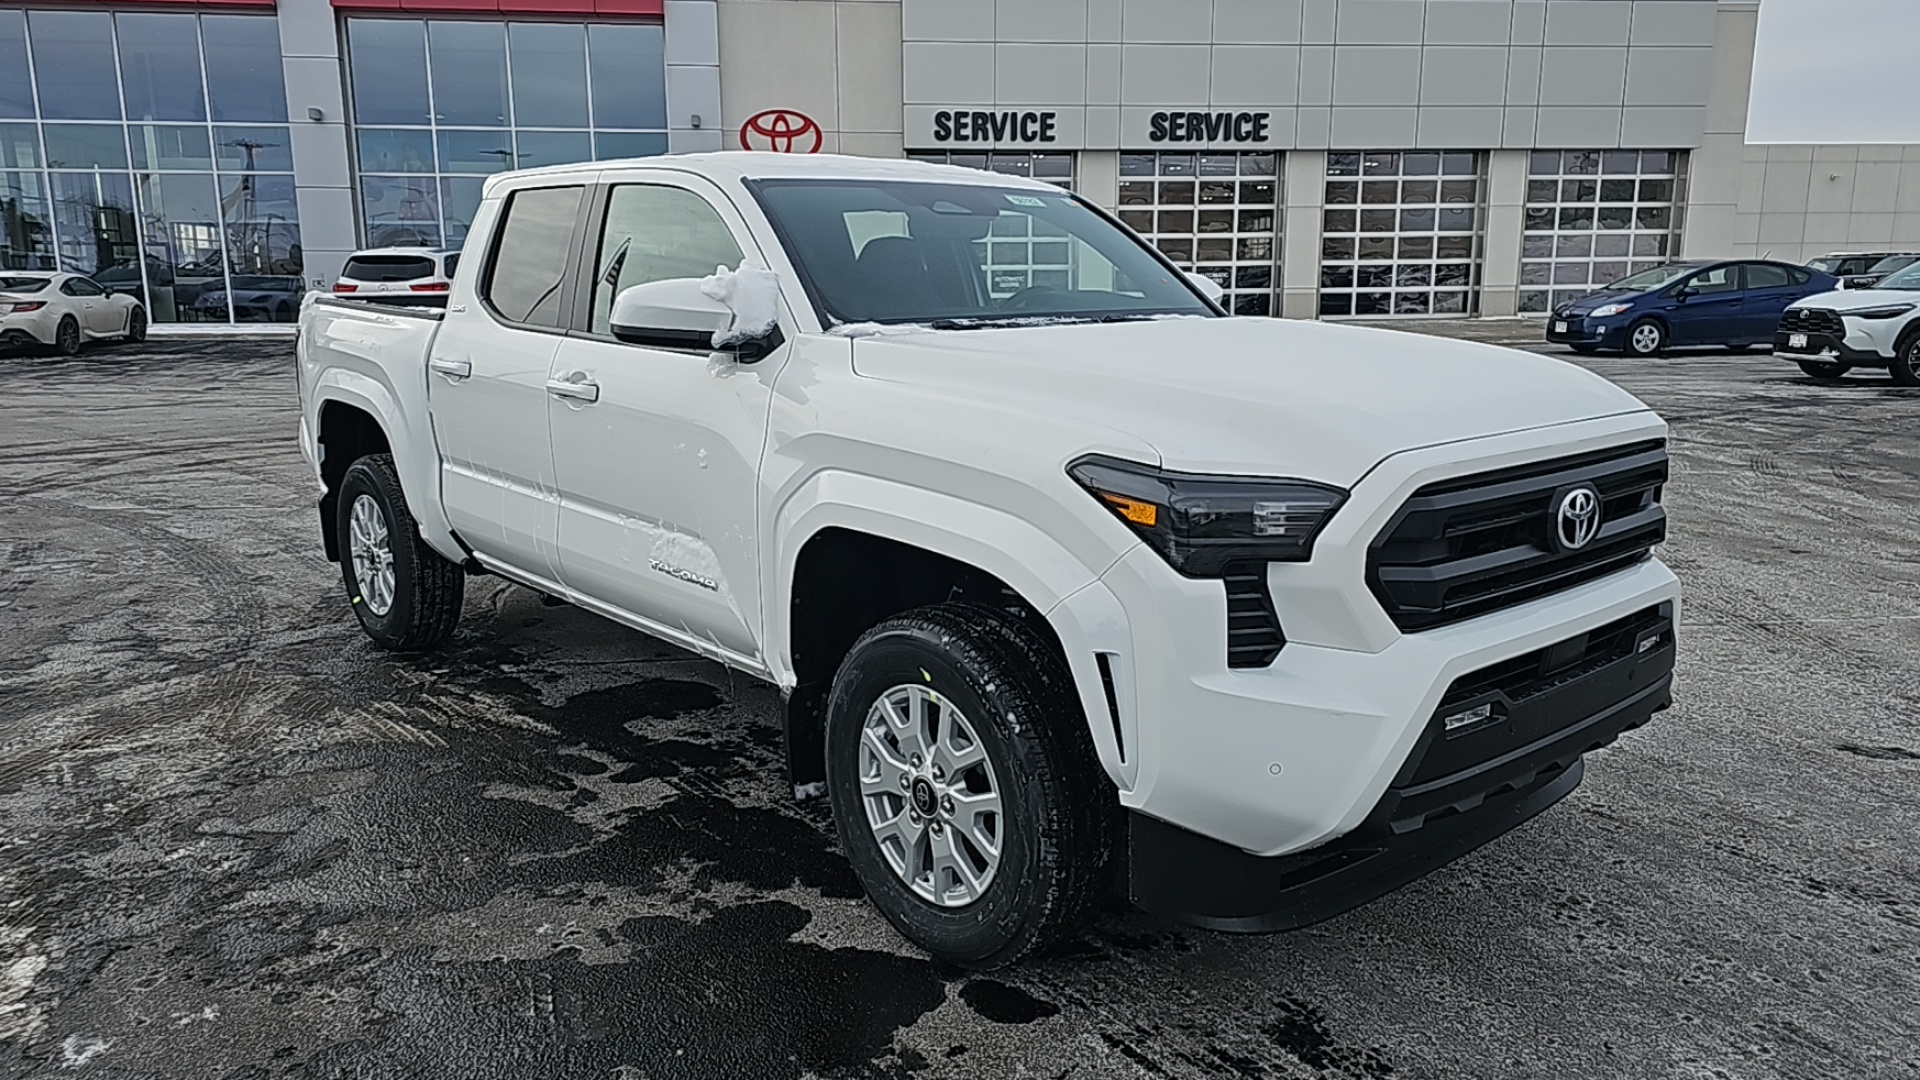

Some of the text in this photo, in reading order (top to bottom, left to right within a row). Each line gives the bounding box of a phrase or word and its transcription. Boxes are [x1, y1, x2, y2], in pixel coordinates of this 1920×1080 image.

[933, 110, 1056, 143] SERVICE
[1148, 111, 1270, 143] SERVICE
[647, 557, 718, 592] TACOMA
